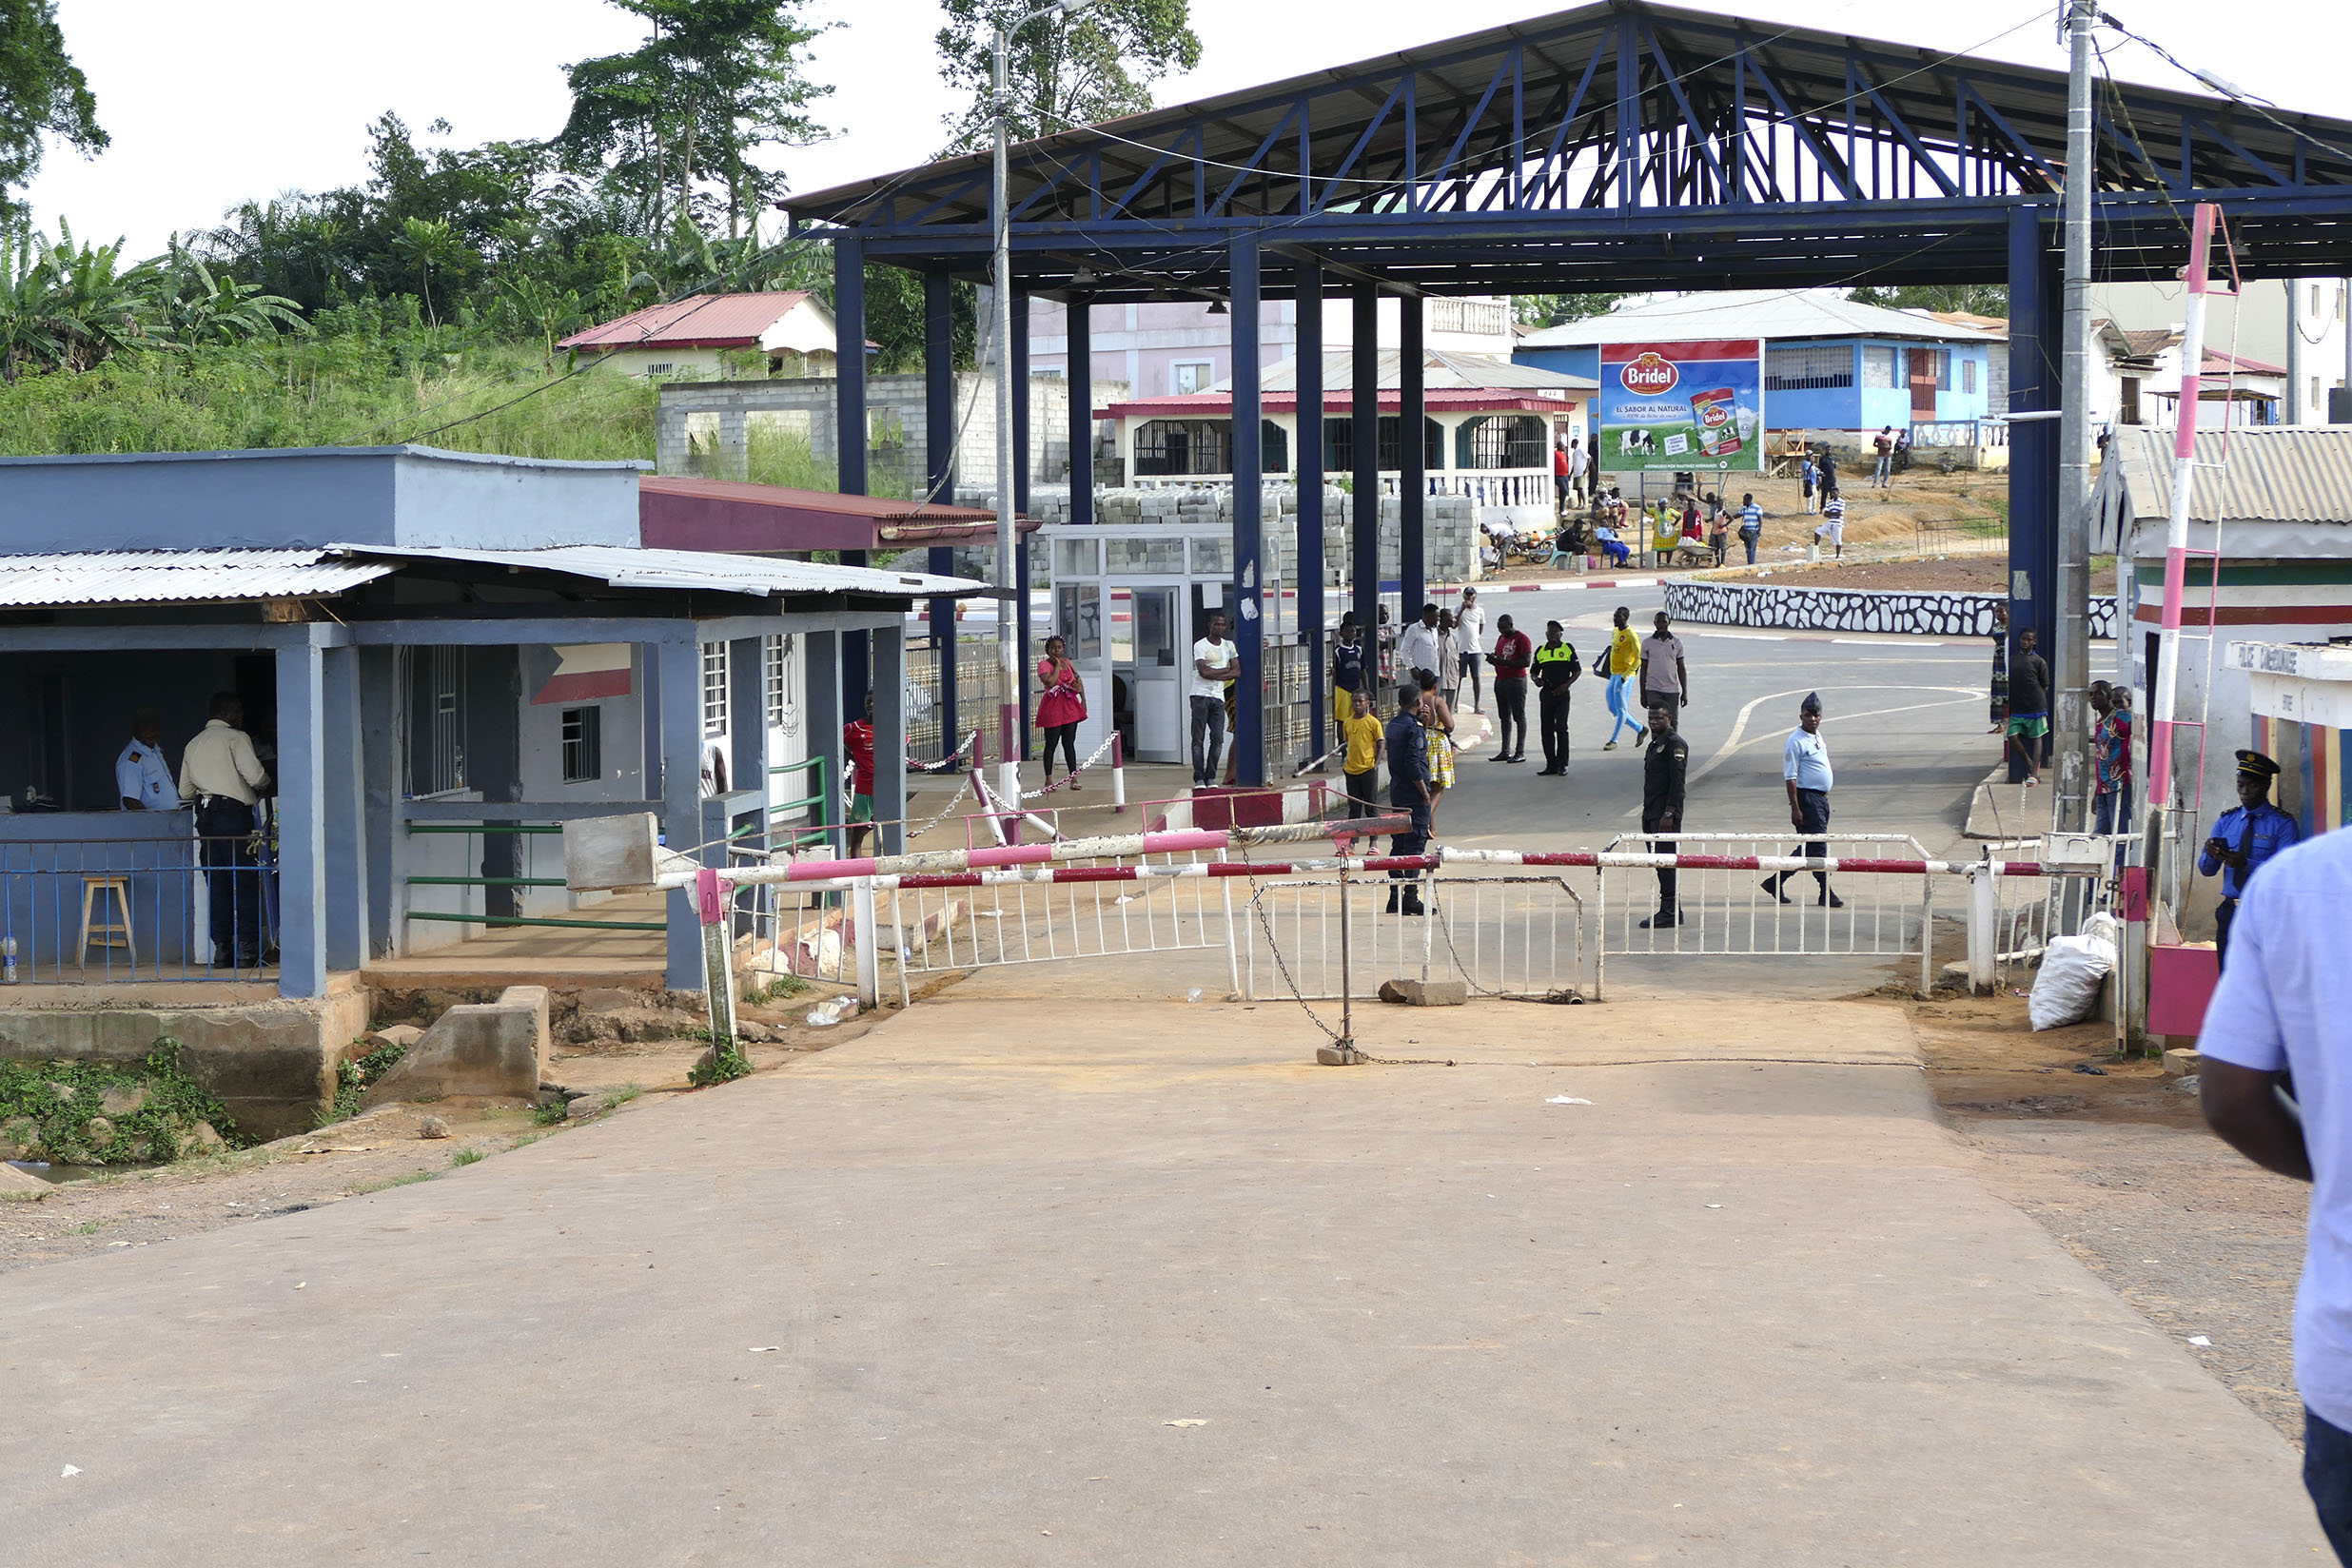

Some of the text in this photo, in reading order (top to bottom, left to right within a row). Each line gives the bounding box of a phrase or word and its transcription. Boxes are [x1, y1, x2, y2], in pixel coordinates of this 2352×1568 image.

[1628, 367, 1672, 383] Bridel
[1657, 404, 1687, 413] NATURAL
[1704, 412, 1726, 423] Bridel
